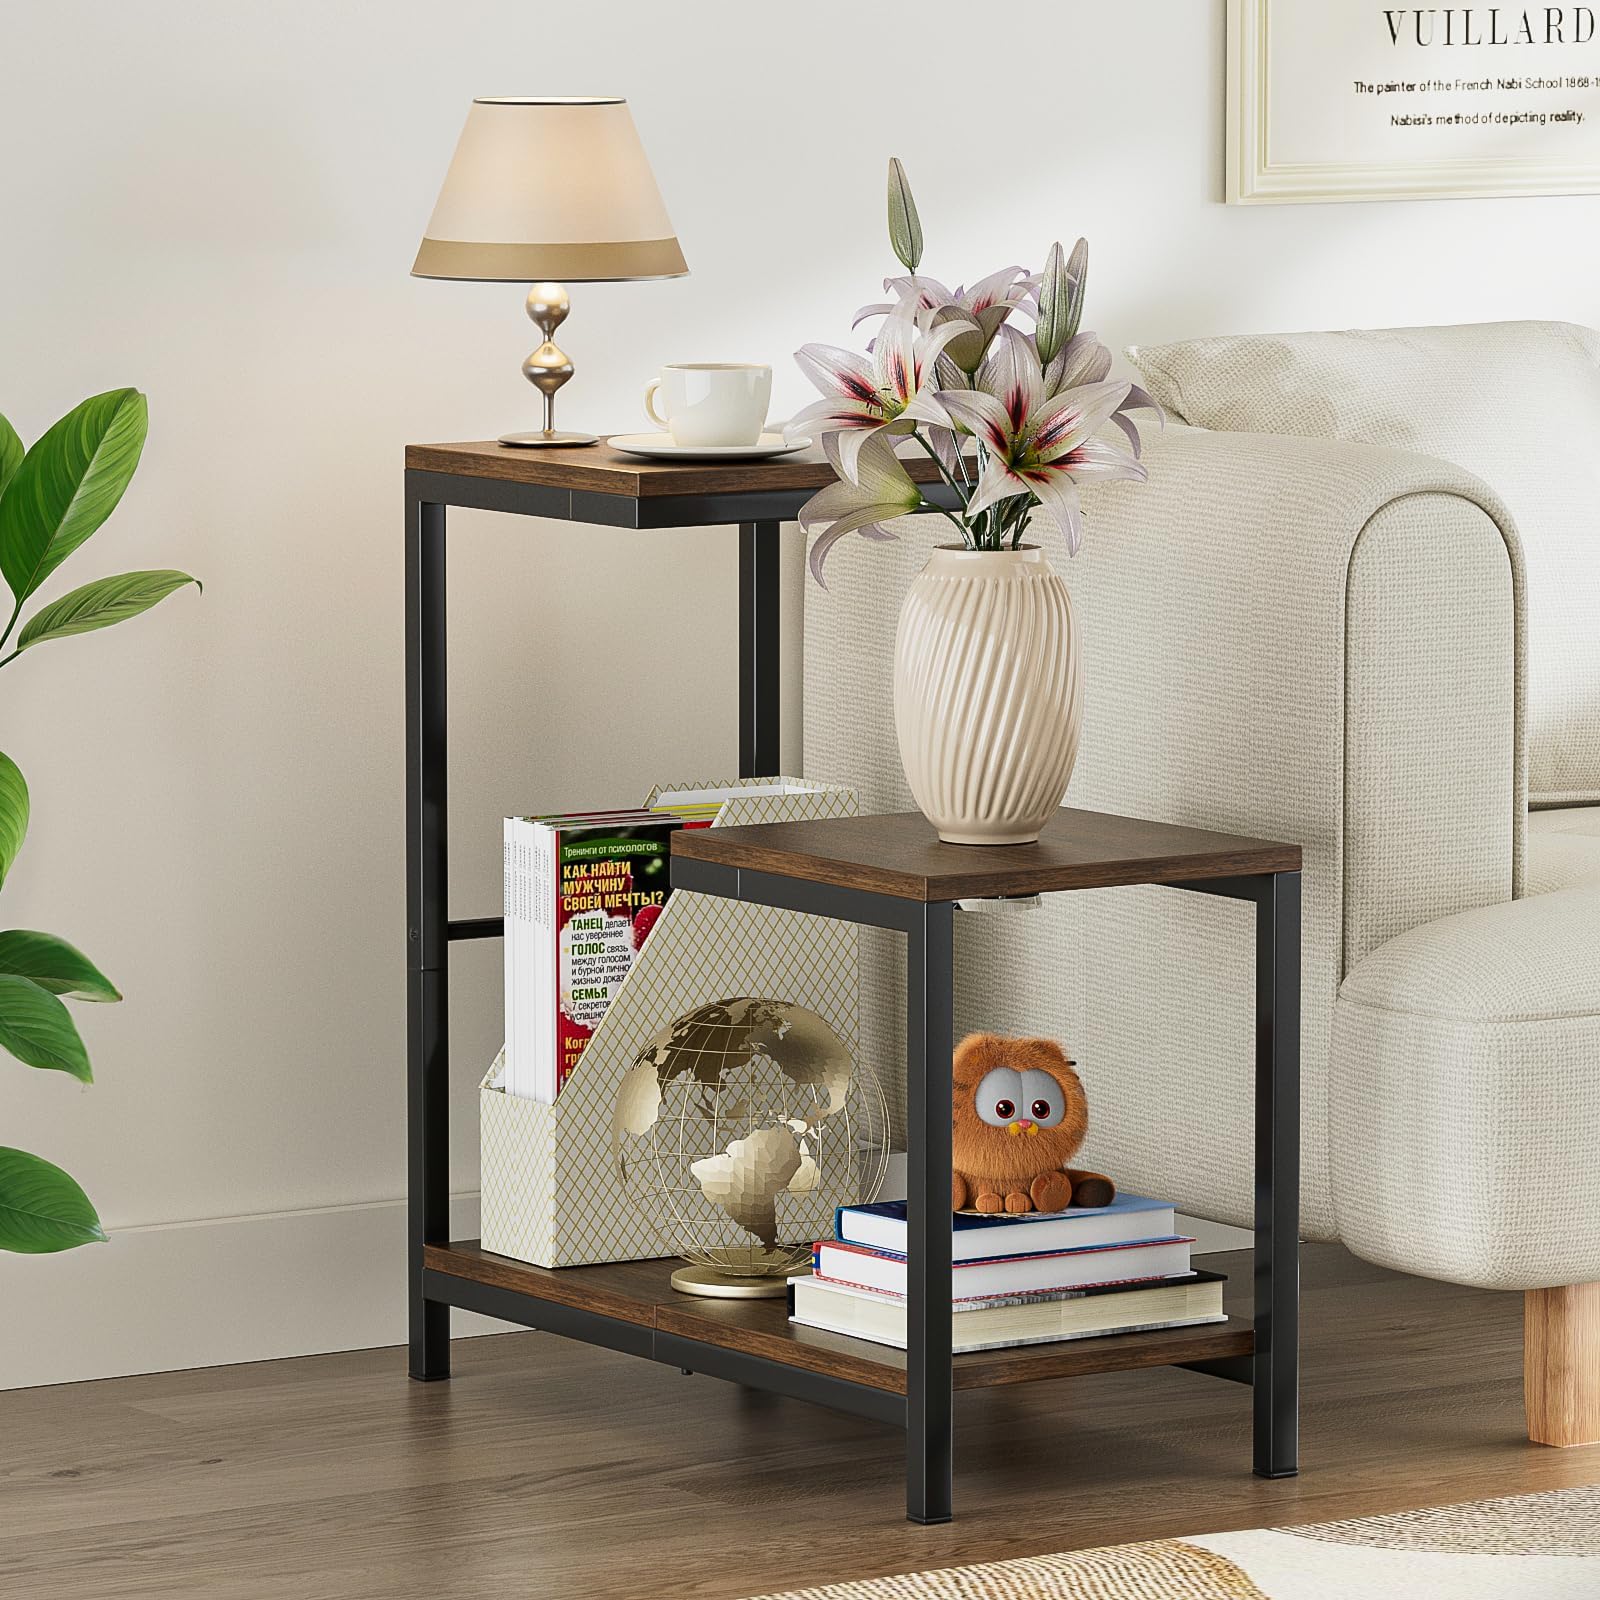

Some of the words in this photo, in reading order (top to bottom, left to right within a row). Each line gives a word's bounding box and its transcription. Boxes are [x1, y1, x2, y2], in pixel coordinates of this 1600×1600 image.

[1383, 7, 1596, 47] VUILLARD
[1354, 82, 1374, 94] The
[1377, 81, 1416, 95] painter
[1420, 79, 1431, 92] of
[1432, 79, 1452, 91] the
[1455, 78, 1493, 90] French
[1497, 78, 1522, 89] Nabi
[1525, 77, 1562, 89] School
[1565, 76, 1600, 88] 1868-1
[1436, 112, 1478, 125] method
[1481, 111, 1494, 124] of
[1495, 111, 1545, 125] depicting
[564, 847, 597, 858] Тренинги
[608, 843, 657, 854] психологов
[563, 864, 588, 879] КАК
[591, 860, 631, 877] НАЙТИ
[563, 878, 625, 895] МУЖЧИНУ
[563, 893, 601, 911] СВОЕЙ
[605, 891, 664, 908] МЕЧТЫ?
[571, 918, 603, 931] ТАНЕЦ
[605, 919, 631, 930] делает
[572, 933, 584, 941] нас
[586, 930, 623, 942] увереннее
[572, 942, 605, 956] ГОЛОС
[607, 945, 628, 953] связь
[572, 957, 596, 966] между
[598, 955, 630, 964] голосом
[578, 965, 604, 977] бурной
[606, 962, 633, 972] лично
[572, 976, 601, 985] жизнью
[603, 974, 626, 984] доказ
[572, 987, 607, 1000] СЕМЬЯ
[572, 1002, 577, 1010] 7
